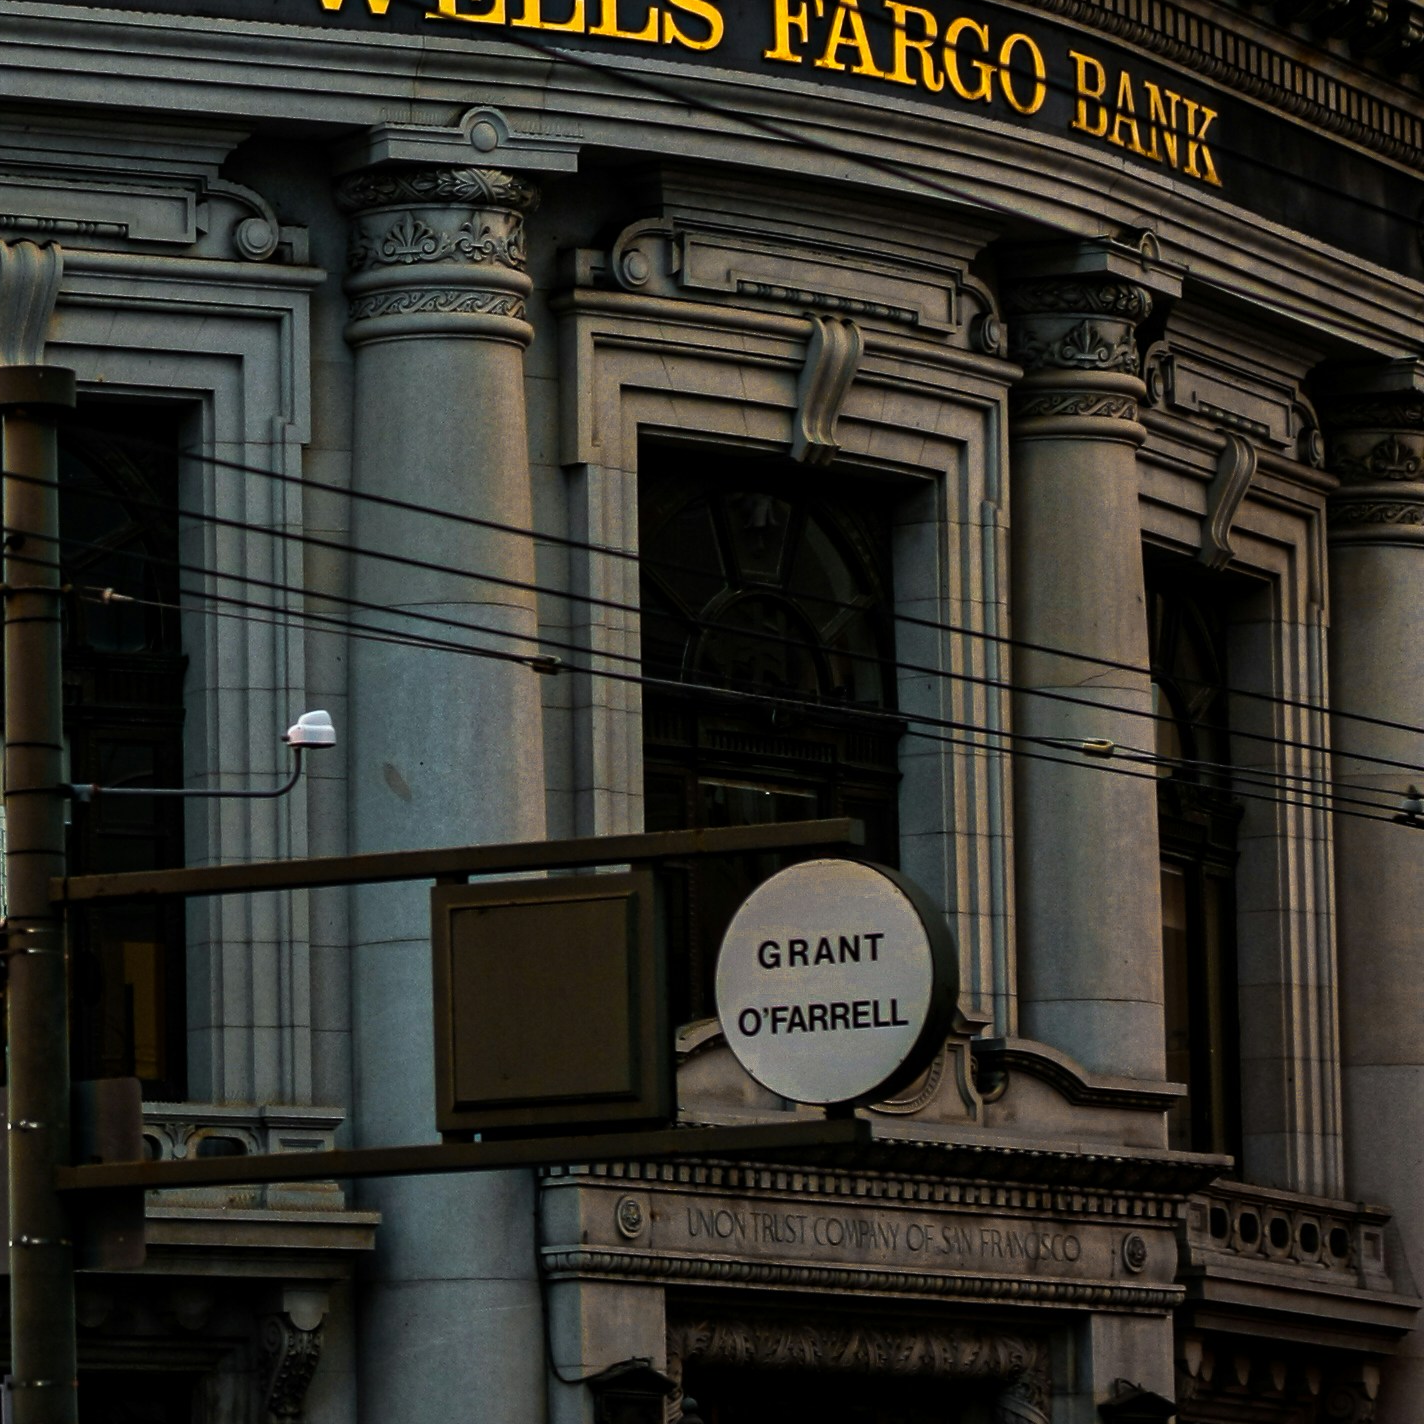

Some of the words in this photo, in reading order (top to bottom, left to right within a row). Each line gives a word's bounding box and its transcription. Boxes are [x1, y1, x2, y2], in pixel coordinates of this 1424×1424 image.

[1068, 49, 1224, 187] BANK
[757, 932, 885, 970] GRANT
[737, 998, 909, 1037] O'FARRELL
[687, 1207, 746, 1239] UNION
[751, 1212, 808, 1244] TRUST
[813, 1216, 900, 1250] COMPANY
[906, 1223, 935, 1253] OF
[941, 1225, 973, 1256] SAN
[979, 1228, 1082, 1262] FRANCISCO
